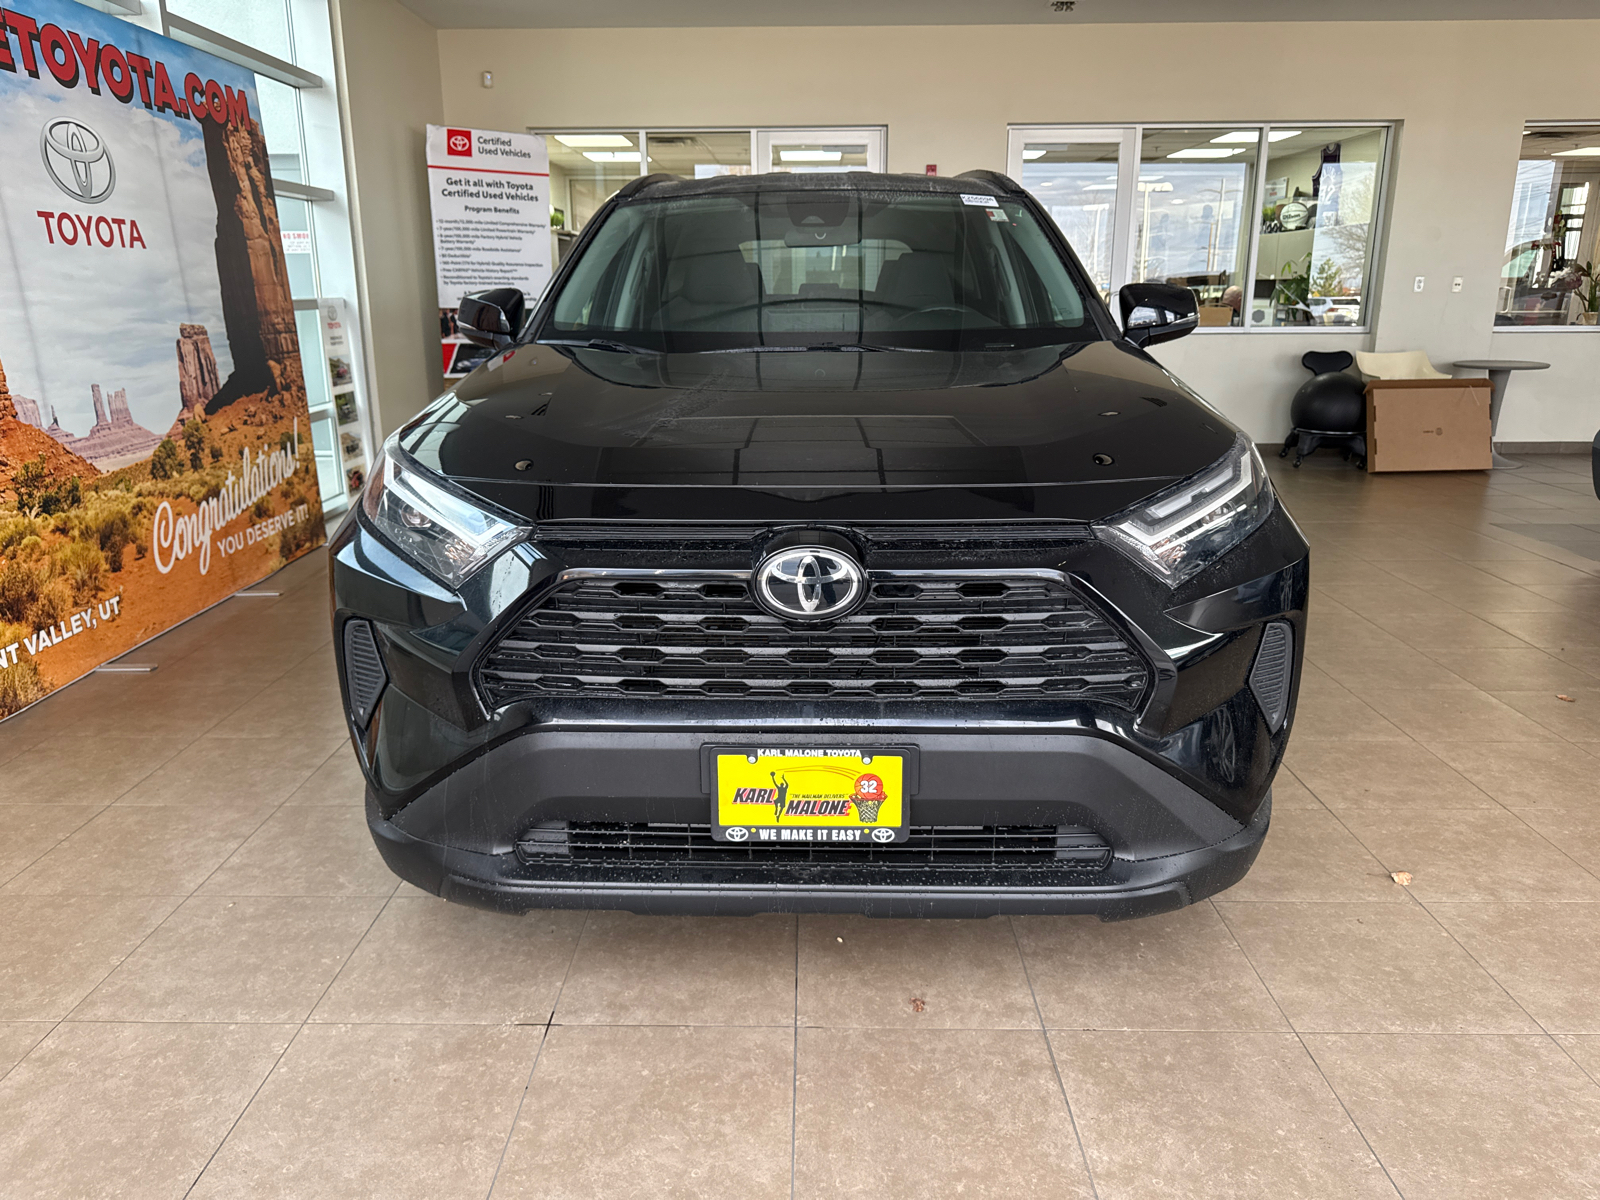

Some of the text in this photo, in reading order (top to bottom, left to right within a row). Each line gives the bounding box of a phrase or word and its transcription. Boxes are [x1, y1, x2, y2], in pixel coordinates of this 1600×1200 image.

[477, 136, 512, 147] Certified
[478, 146, 531, 159] Used Vehicles
[446, 177, 534, 191] Get it all with Toyota
[441, 188, 539, 202] Certified Used Vehicles
[464, 205, 520, 215] Program Benefits
[36, 210, 147, 250] TOYOTA
[153, 416, 301, 575] Congratulations!
[216, 503, 309, 558] YOU DESERVE IT!
[23, 608, 97, 656] VALLEY,
[98, 596, 120, 620] UT
[757, 749, 861, 758] KARL MALONE TOYOTA
[860, 780, 878, 793] 32
[732, 788, 777, 804] KARL
[784, 800, 851, 817] MALONE
[759, 829, 861, 841] WE MAKE IT EASY
